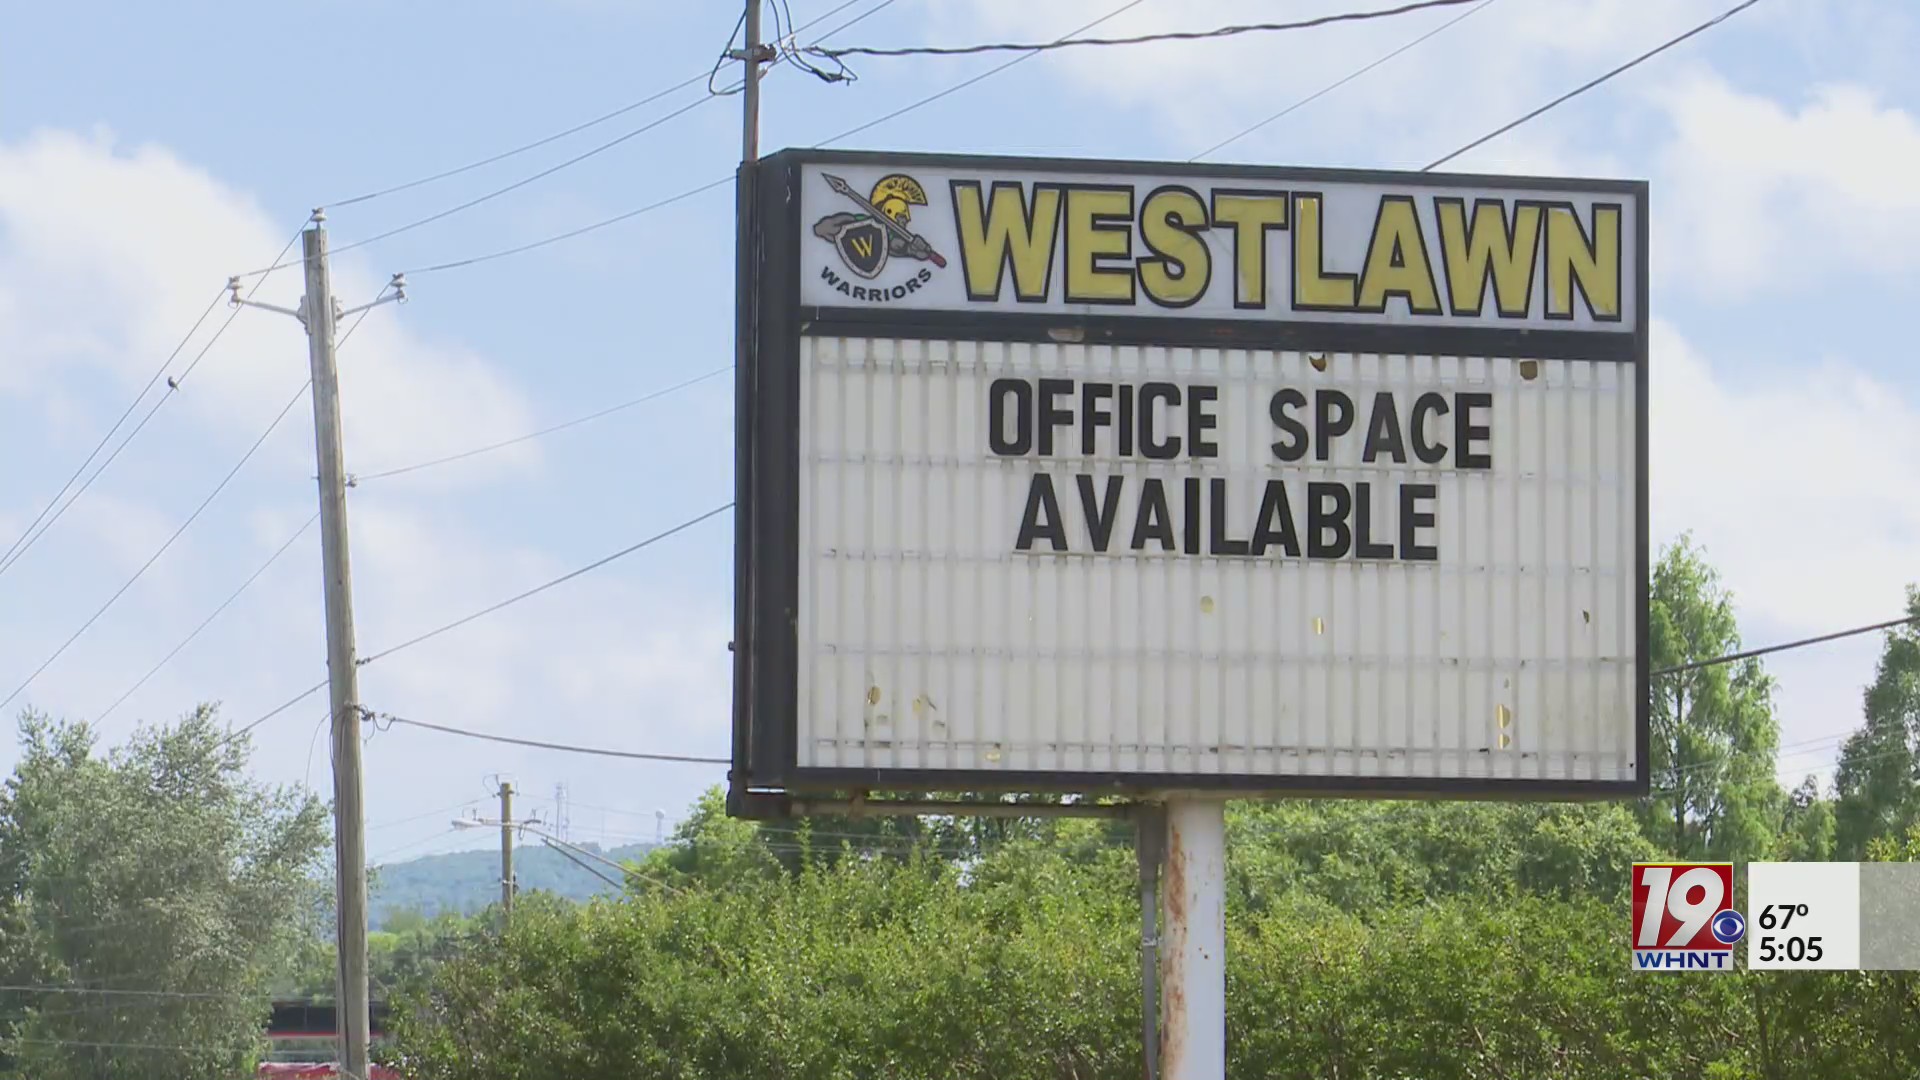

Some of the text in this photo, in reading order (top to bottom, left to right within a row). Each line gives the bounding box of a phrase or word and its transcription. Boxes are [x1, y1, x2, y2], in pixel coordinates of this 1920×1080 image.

[820, 266, 932, 302] WARRIORS
[851, 234, 873, 259] W
[949, 179, 1621, 322] WESTLAWN
[989, 378, 1492, 469] OFFICE SPACE
[1016, 474, 1438, 561] AVAILABLE
